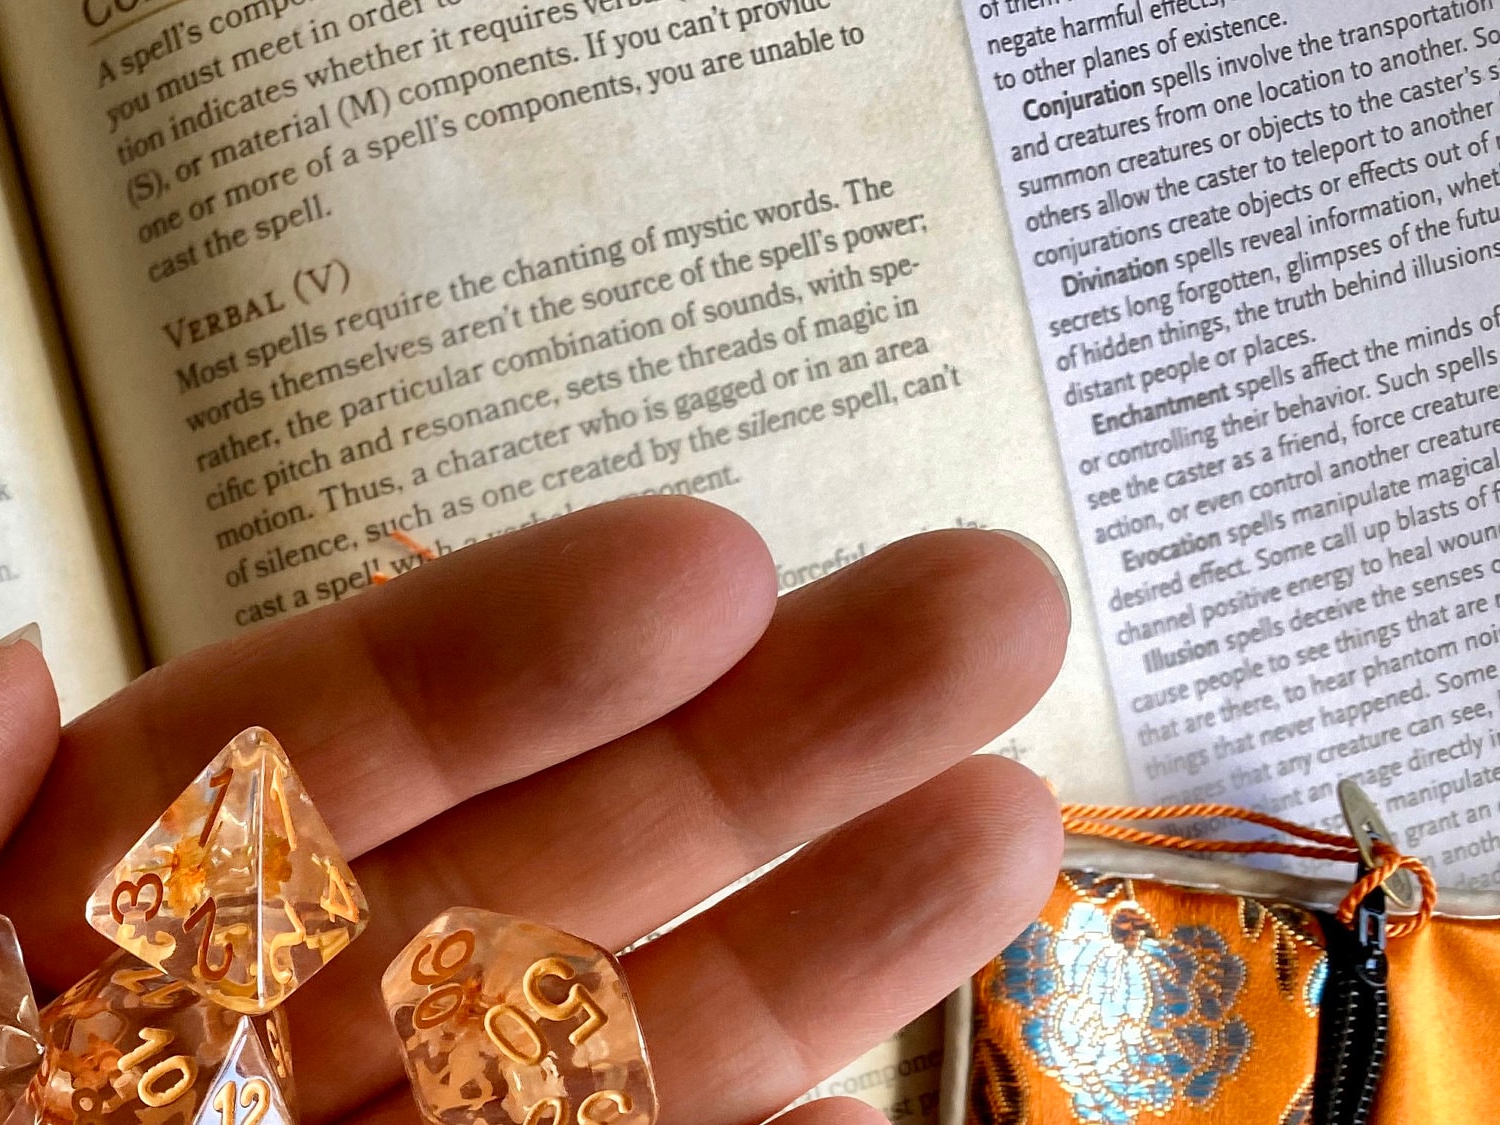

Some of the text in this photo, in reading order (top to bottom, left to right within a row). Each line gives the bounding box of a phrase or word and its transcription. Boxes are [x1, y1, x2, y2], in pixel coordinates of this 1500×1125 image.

[993, 12, 1288, 92] to other planes of existence.
[1022, 0, 1494, 122] Conjuration spells involve the transportation
[138, 26, 865, 244] one or more of a spell's components, you are unable to
[148, 244, 199, 283] cast
[203, 228, 249, 259] the
[175, 176, 895, 394] Most spells require the chanting of mystic words. The
[161, 259, 351, 349] VERBAL (V)
[1064, 371, 1136, 407] distant
[1139, 351, 1211, 394] people
[1214, 347, 1237, 368] or
[1091, 316, 1474, 436] Enchantment spells affect the minds
[1121, 531, 1222, 573] Evocation
[1226, 509, 1287, 547] spells
[1291, 479, 1411, 525] manipulate
[117, 1027, 198, 1107] 10
